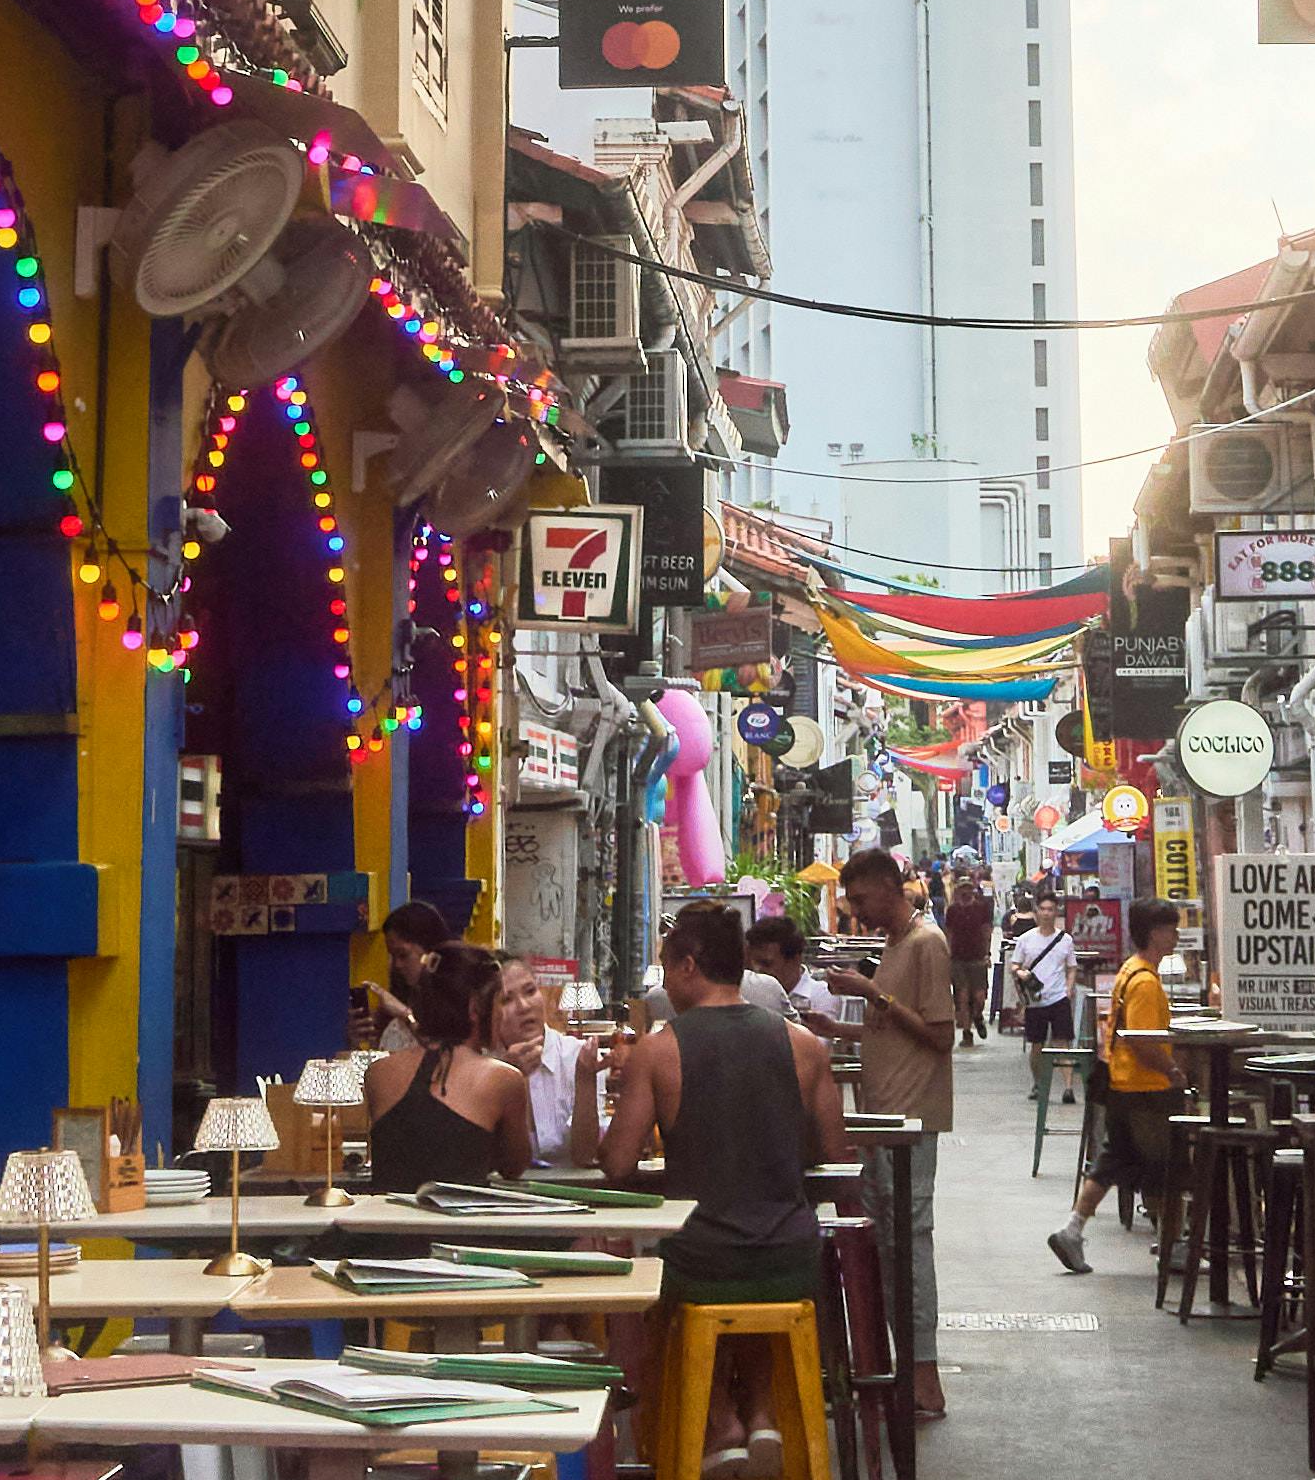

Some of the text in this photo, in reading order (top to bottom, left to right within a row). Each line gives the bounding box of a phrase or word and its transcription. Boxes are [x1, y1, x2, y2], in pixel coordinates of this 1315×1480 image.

[618, 4, 664, 15] We prefer
[1227, 548, 1249, 571] EAT
[1249, 534, 1275, 553] FOR
[1277, 533, 1315, 547] MORE
[660, 555, 695, 571] BEER
[545, 527, 608, 618] 7
[1125, 654, 1179, 667] DAWAT
[1188, 735, 1265, 754] COCLICO
[1230, 864, 1288, 894] LOVE
[1243, 899, 1311, 930] COME
[1238, 979, 1256, 994] MR
[1258, 978, 1291, 994] LIM'S
[1238, 997, 1278, 1011] VISUAL
